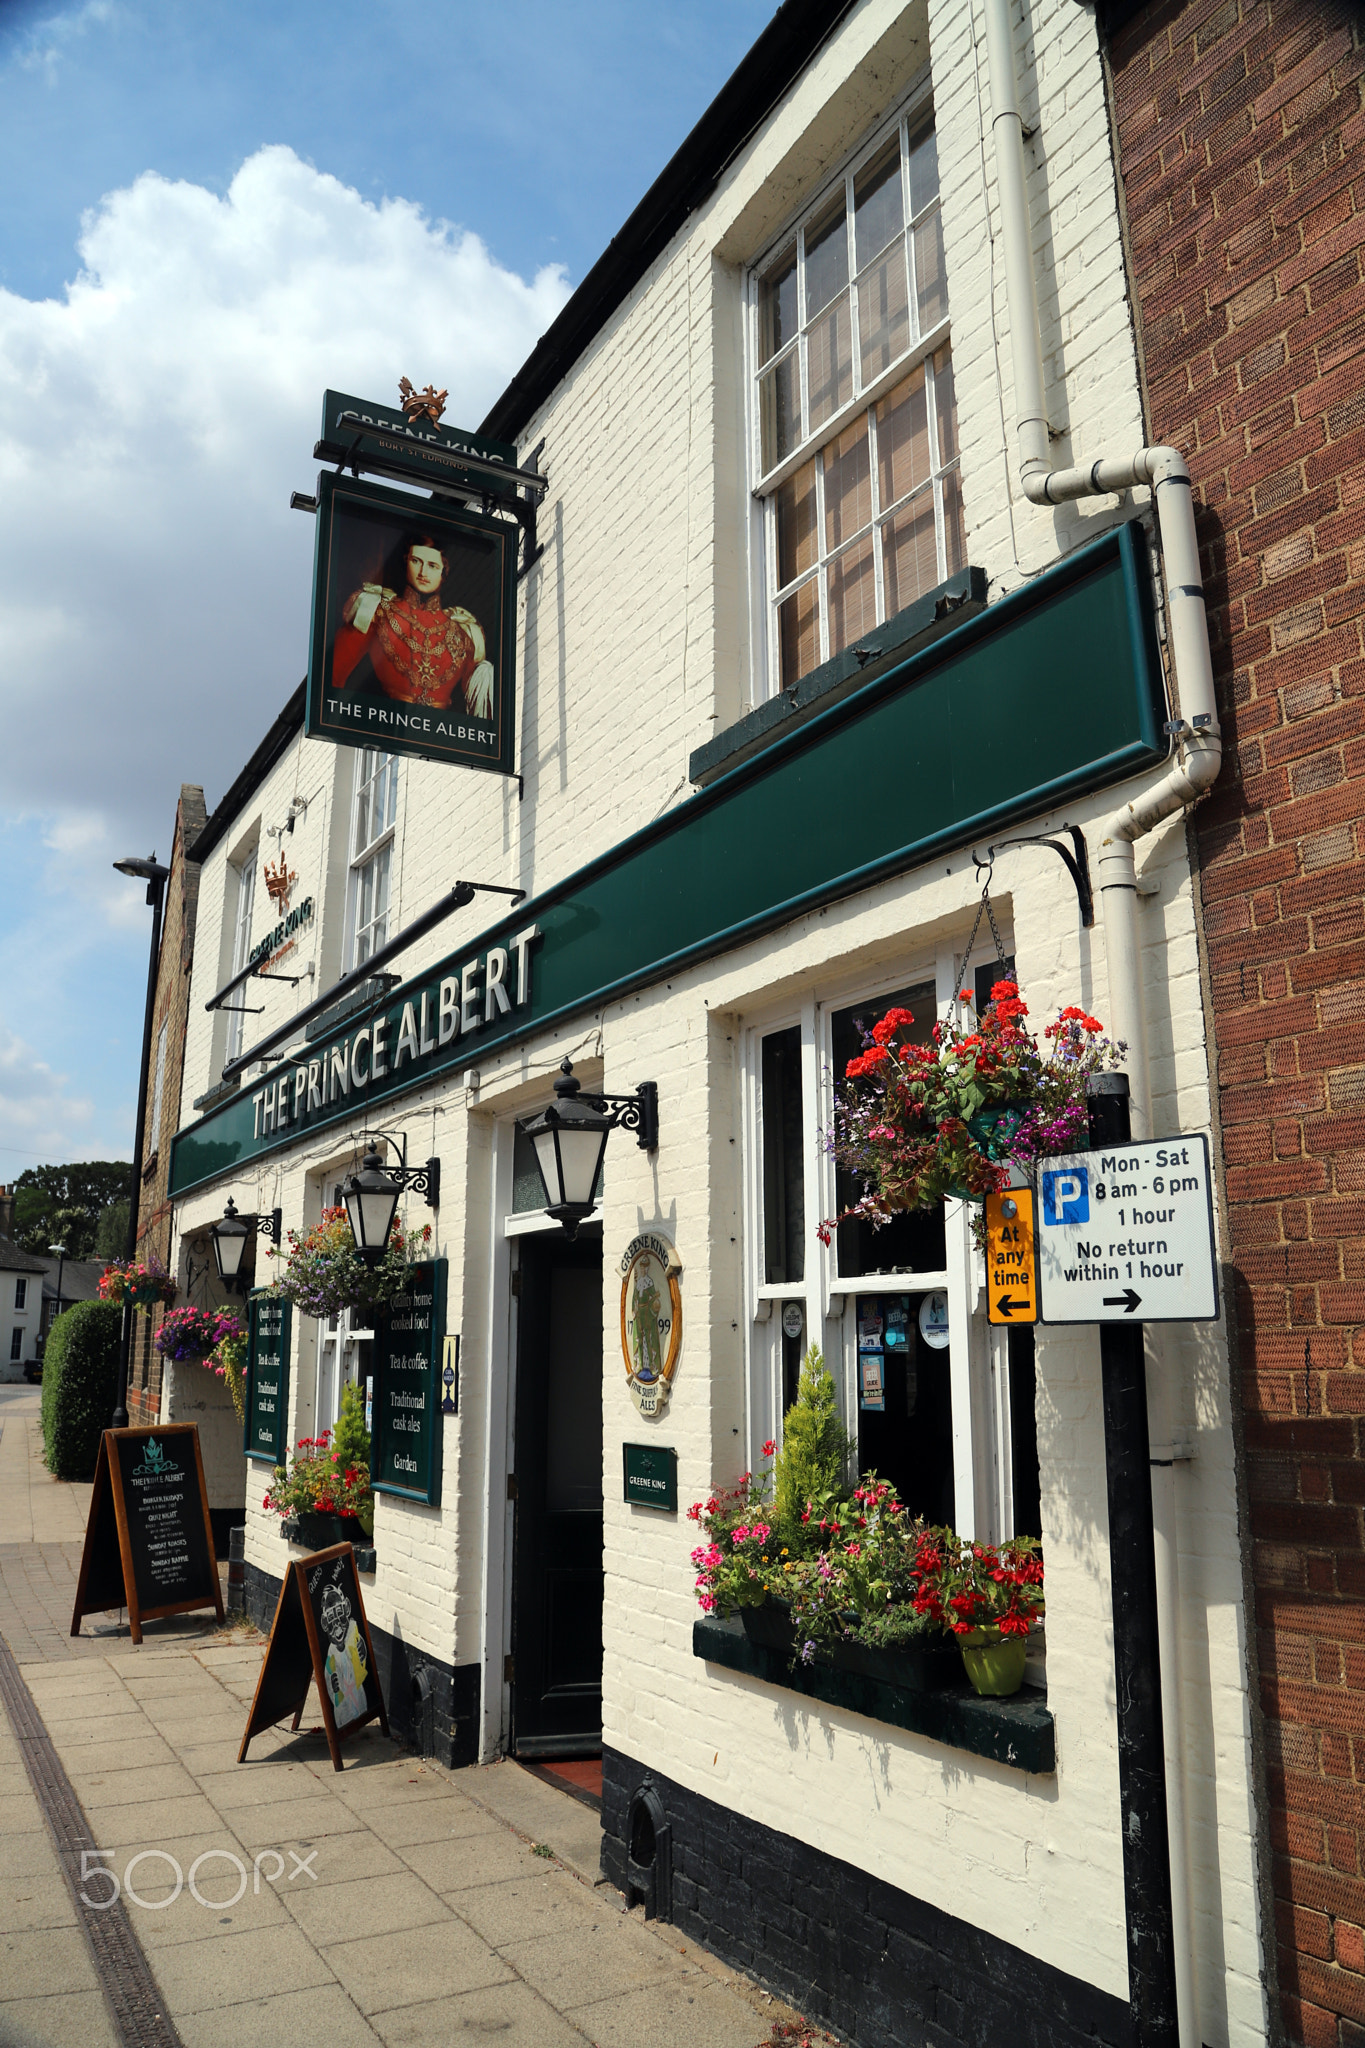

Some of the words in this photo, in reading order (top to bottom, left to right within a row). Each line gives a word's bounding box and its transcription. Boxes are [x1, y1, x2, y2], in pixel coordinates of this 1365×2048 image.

[327, 699, 362, 718] THE
[368, 707, 431, 732] PRINCE
[435, 722, 497, 745] ALBERT
[285, 896, 312, 937] KING
[252, 1074, 290, 1140] THE
[294, 1016, 388, 1119] PRINCE
[394, 923, 541, 1069] ALBERT
[1101, 1156, 1140, 1174] Mon
[1156, 1148, 1189, 1169] Sat
[1054, 1175, 1082, 1220] P
[1095, 1183, 1106, 1200] 8
[1111, 1183, 1137, 1198] am
[1153, 1177, 1165, 1194] 6
[1170, 1177, 1199, 1195] pm
[1118, 1209, 1125, 1226] 1
[1132, 1208, 1176, 1225] hour
[1001, 1227, 1019, 1243] At
[620, 1235, 650, 1272] GREENE
[650, 1236, 669, 1268] KING
[1077, 1242, 1102, 1258] No
[1109, 1238, 1168, 1257] return
[996, 1250, 1025, 1266] any
[994, 1269, 1029, 1286] time
[1063, 1263, 1119, 1282] within
[1125, 1262, 1132, 1279] 1
[1140, 1261, 1184, 1278] hour
[413, 1290, 432, 1307] home
[391, 1313, 413, 1330] cooked
[414, 1312, 429, 1330] food
[658, 1319, 671, 1336] 99
[390, 1354, 401, 1369] Tea
[401, 1354, 407, 1369] &
[408, 1352, 428, 1370] coffee
[390, 1390, 425, 1409] Traditional
[639, 1398, 656, 1411] ALES
[392, 1413, 407, 1431] cask
[407, 1414, 421, 1433] ales
[393, 1453, 417, 1473] Garden
[629, 1476, 651, 1487] GREENE
[651, 1479, 666, 1490] KING
